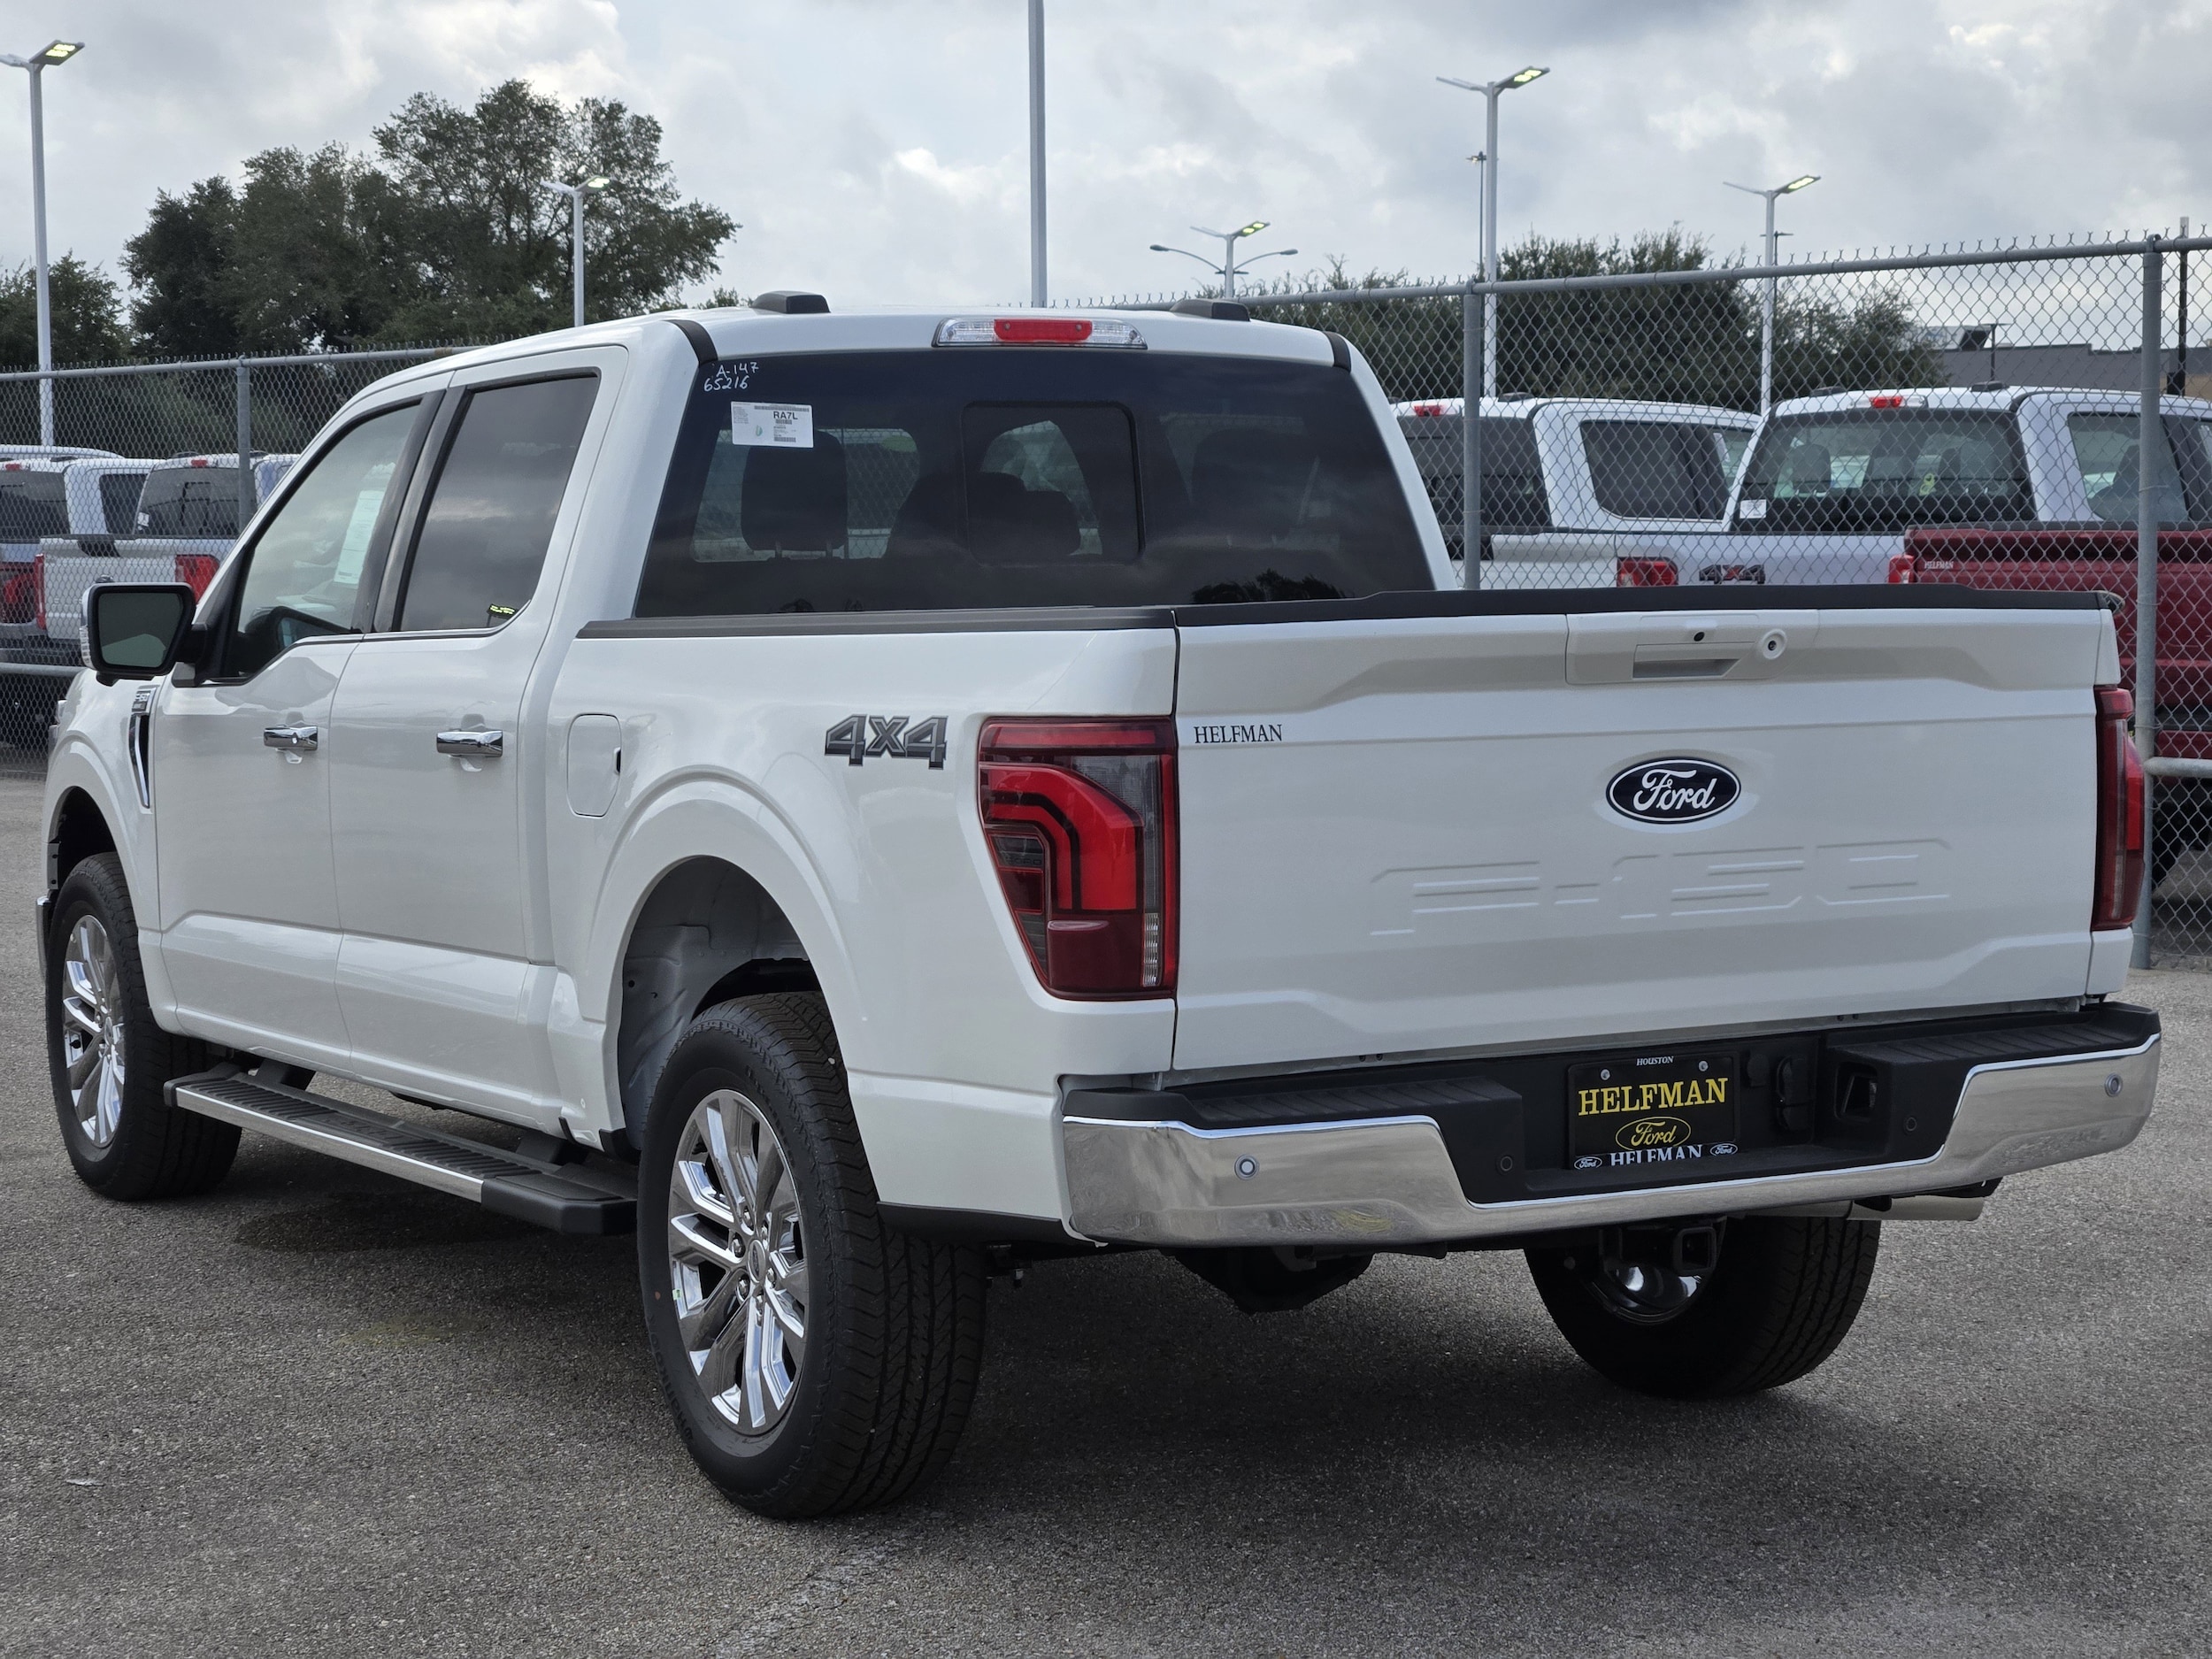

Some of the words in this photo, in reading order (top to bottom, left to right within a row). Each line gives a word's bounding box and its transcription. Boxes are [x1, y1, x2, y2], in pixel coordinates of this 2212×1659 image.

[716, 361, 759, 378] A-147
[703, 375, 750, 392] 65216
[772, 411, 798, 420] RA7L
[1193, 724, 1283, 744] HELFMAN
[1632, 768, 1717, 811] Ford
[1636, 1056, 1674, 1066] HOUSTON
[1578, 1077, 1729, 1117] HELFMAN
[1630, 1120, 1678, 1148] Ford
[1578, 1158, 1597, 1168] Ford
[1714, 1143, 1733, 1155] Ford
